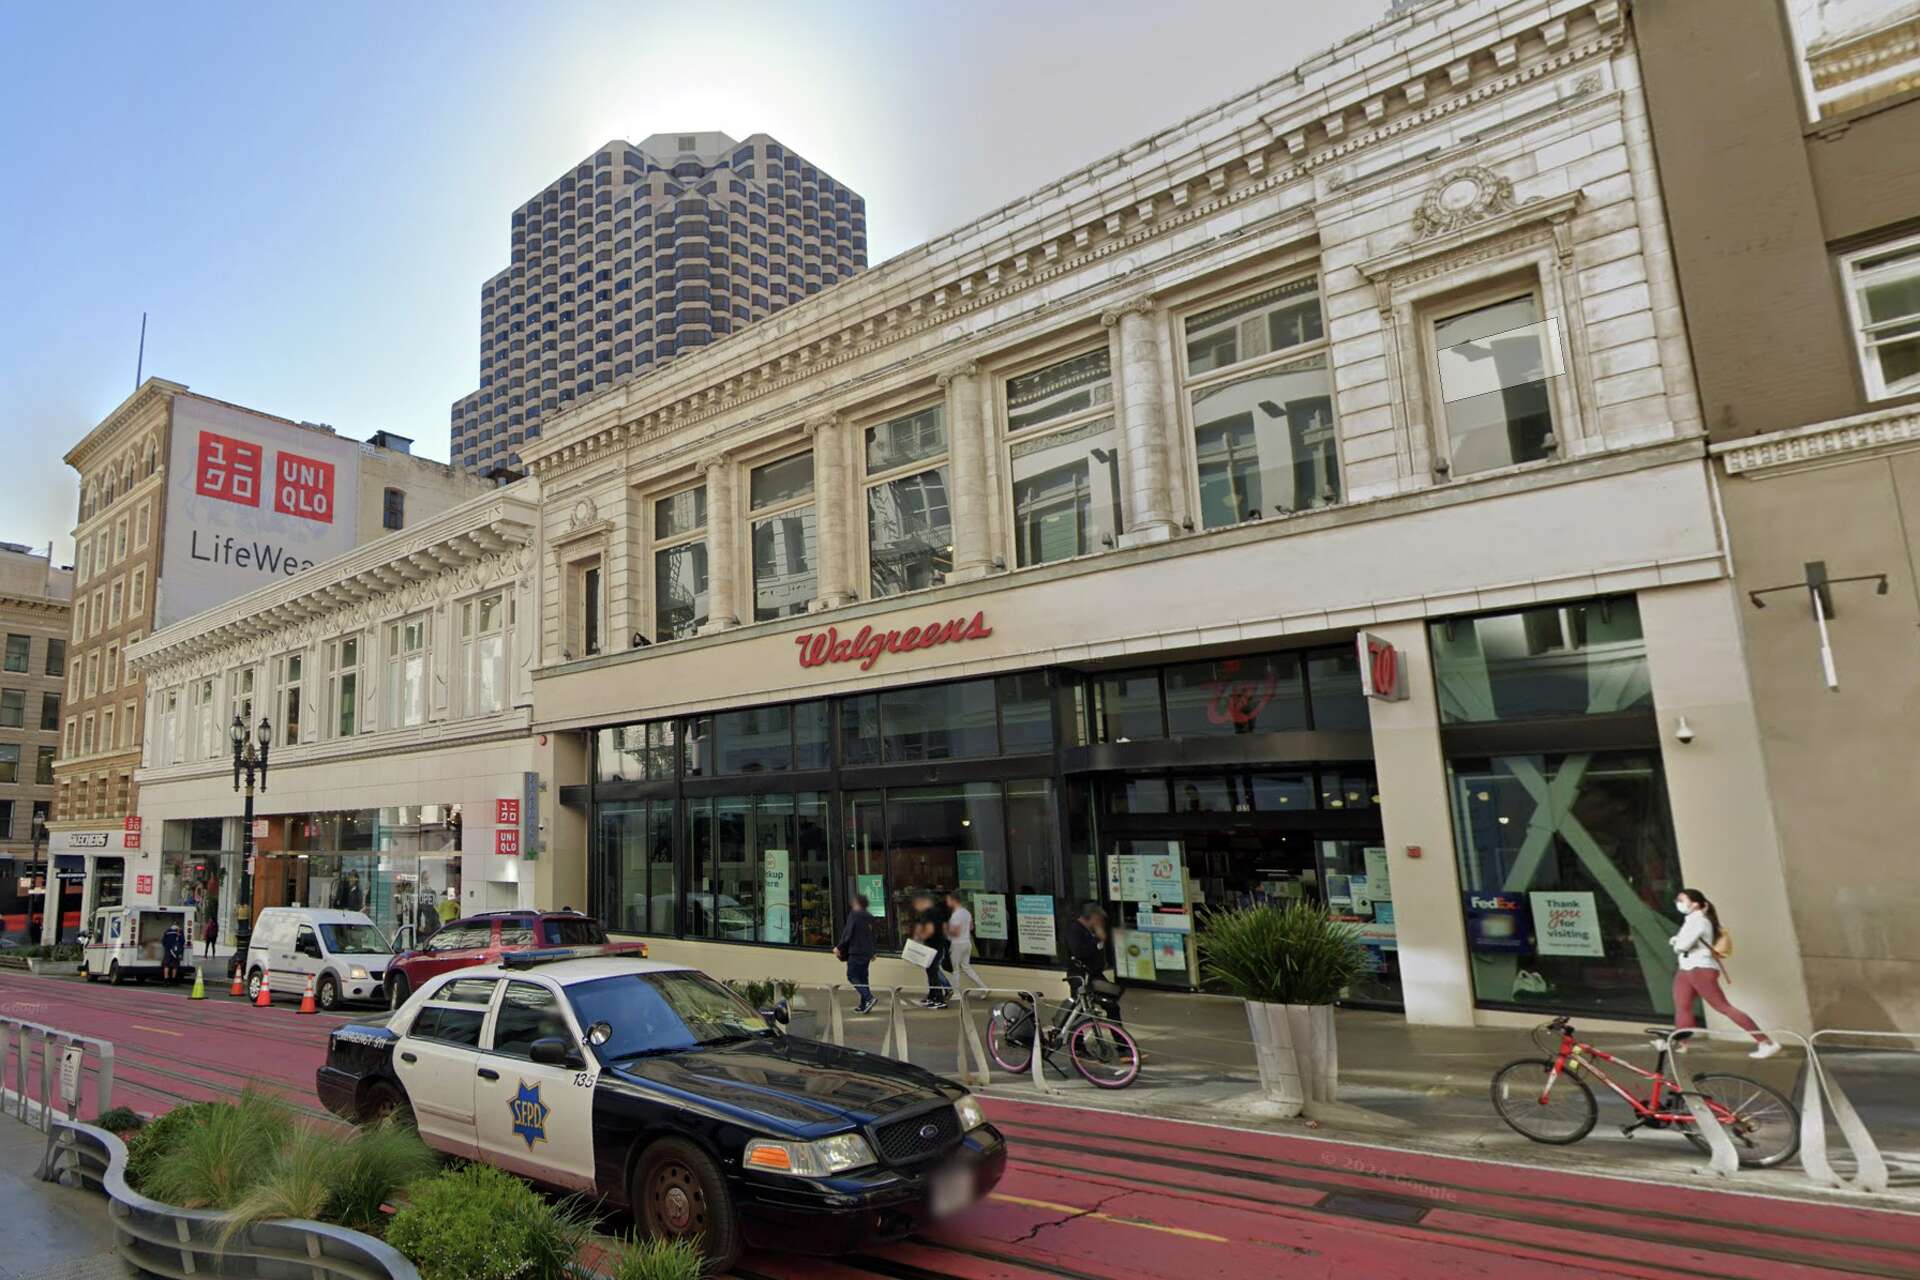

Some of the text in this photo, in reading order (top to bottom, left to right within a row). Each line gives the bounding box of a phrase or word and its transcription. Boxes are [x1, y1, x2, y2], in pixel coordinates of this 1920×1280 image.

[283, 460, 324, 488] UNI
[281, 486, 327, 514] QLO
[795, 611, 992, 671] Walgreens
[500, 832, 515, 841] UNI
[500, 842, 516, 853] QLO
[1471, 896, 1519, 909] FedEx
[1546, 900, 1580, 908] Thank
[1548, 910, 1584, 929] you
[1560, 920, 1576, 928] for
[1547, 930, 1590, 940] visiting
[573, 1072, 596, 1088] 135
